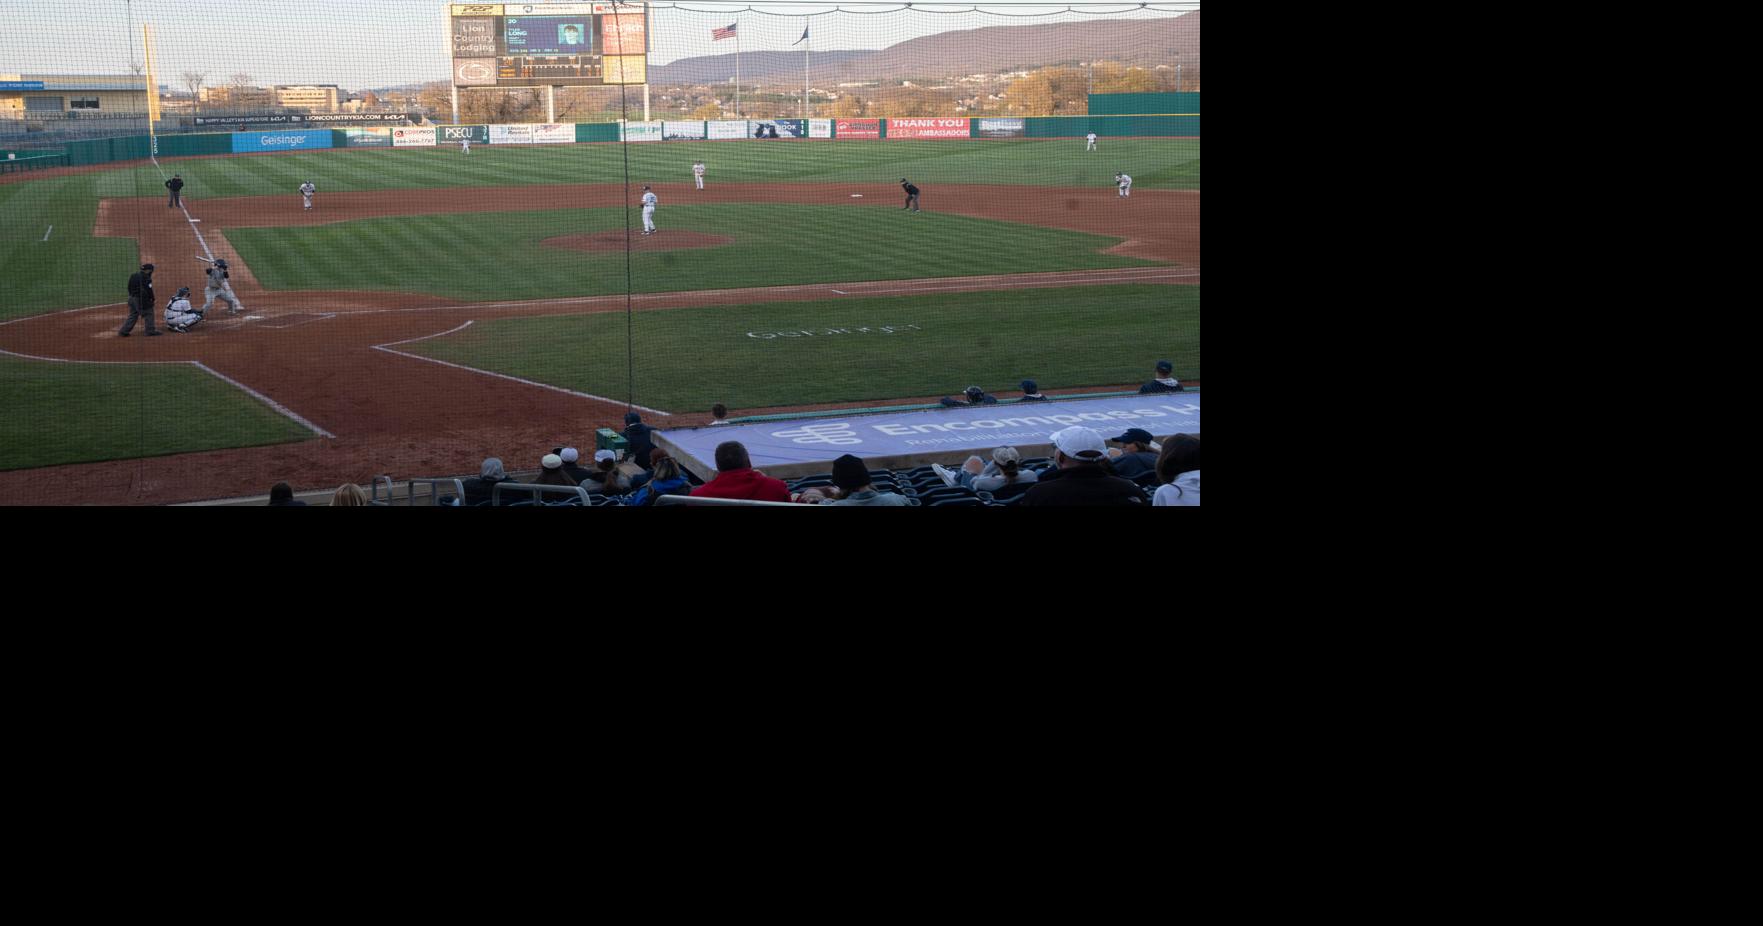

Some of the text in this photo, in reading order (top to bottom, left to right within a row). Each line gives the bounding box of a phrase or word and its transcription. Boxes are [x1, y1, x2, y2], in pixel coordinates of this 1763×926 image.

[454, 34, 494, 43] Country
[454, 44, 495, 52] Lodging
[892, 119, 964, 128] THANK YOU
[445, 127, 473, 139] PSECU
[918, 129, 970, 137] AMBASSADORS
[261, 134, 306, 147] Geisinger
[872, 409, 1168, 437] Encompass
